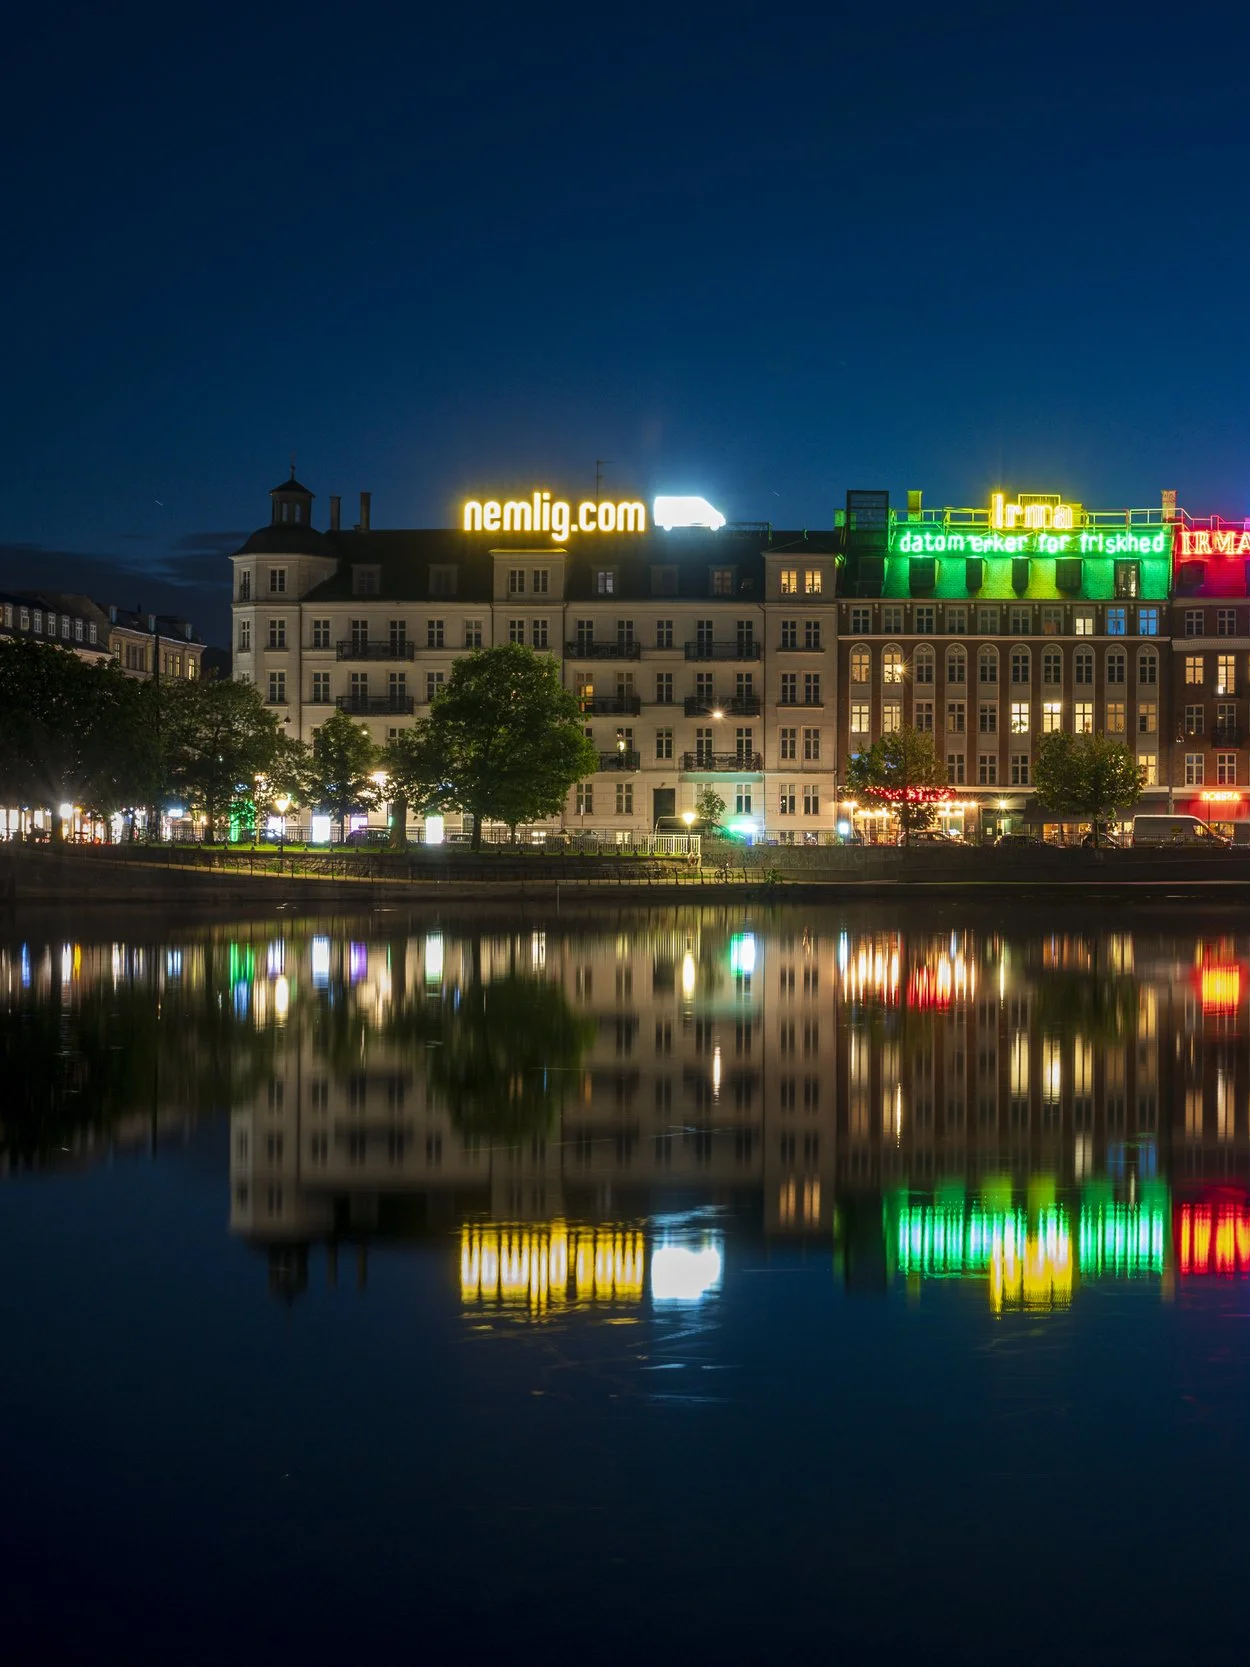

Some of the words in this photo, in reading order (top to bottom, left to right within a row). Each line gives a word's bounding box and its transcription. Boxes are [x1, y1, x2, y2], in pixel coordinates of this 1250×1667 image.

[464, 492, 646, 541] nemlig.com
[992, 494, 1073, 528] Irma
[1038, 532, 1070, 553] for
[1080, 531, 1164, 553] friskhed
